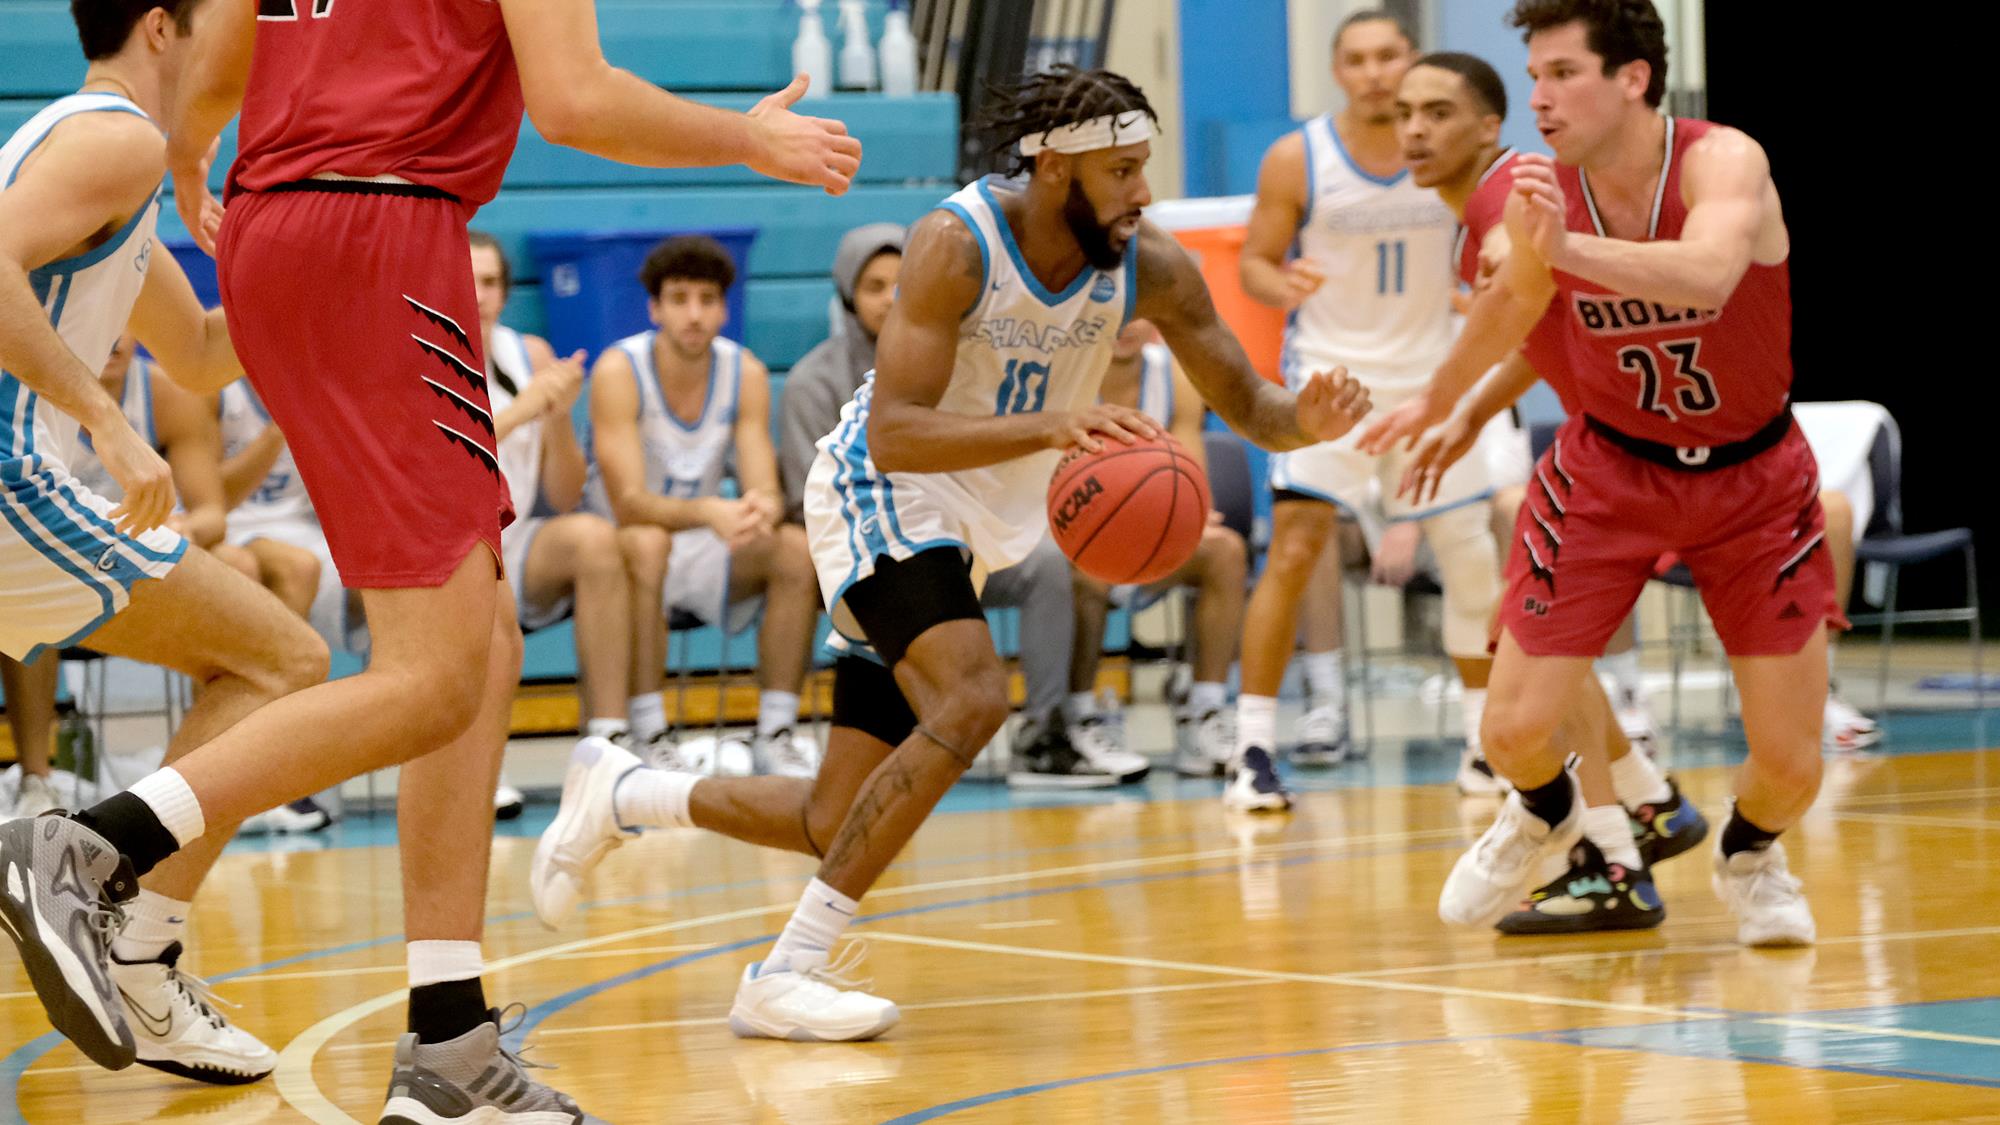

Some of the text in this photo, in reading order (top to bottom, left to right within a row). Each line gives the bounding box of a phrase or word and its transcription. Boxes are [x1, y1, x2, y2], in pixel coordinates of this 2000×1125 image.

[1377, 241, 1405, 294] 11
[1577, 297, 1719, 330] BIOL
[996, 359, 1051, 416] 10
[1617, 338, 1721, 423] 23
[248, 473, 291, 502] 2
[1053, 475, 1104, 536] NCAA
[1523, 595, 1550, 617] BU
